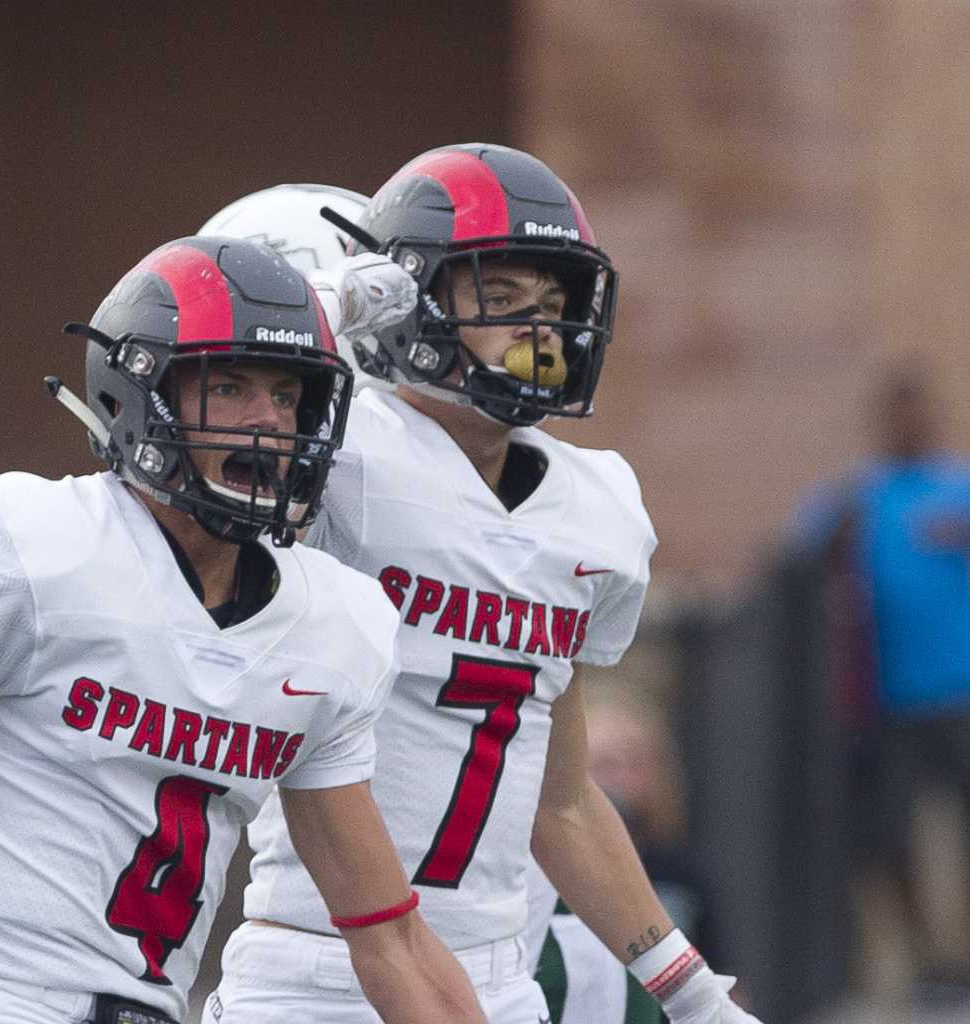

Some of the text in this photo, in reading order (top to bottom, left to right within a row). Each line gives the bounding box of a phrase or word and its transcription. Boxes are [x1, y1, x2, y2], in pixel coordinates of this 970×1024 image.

[256, 326, 314, 348] Riddell
[379, 564, 591, 660] SPARTANS
[61, 676, 306, 780] SPARTANS
[410, 651, 542, 891] 7
[105, 774, 230, 986] 4
